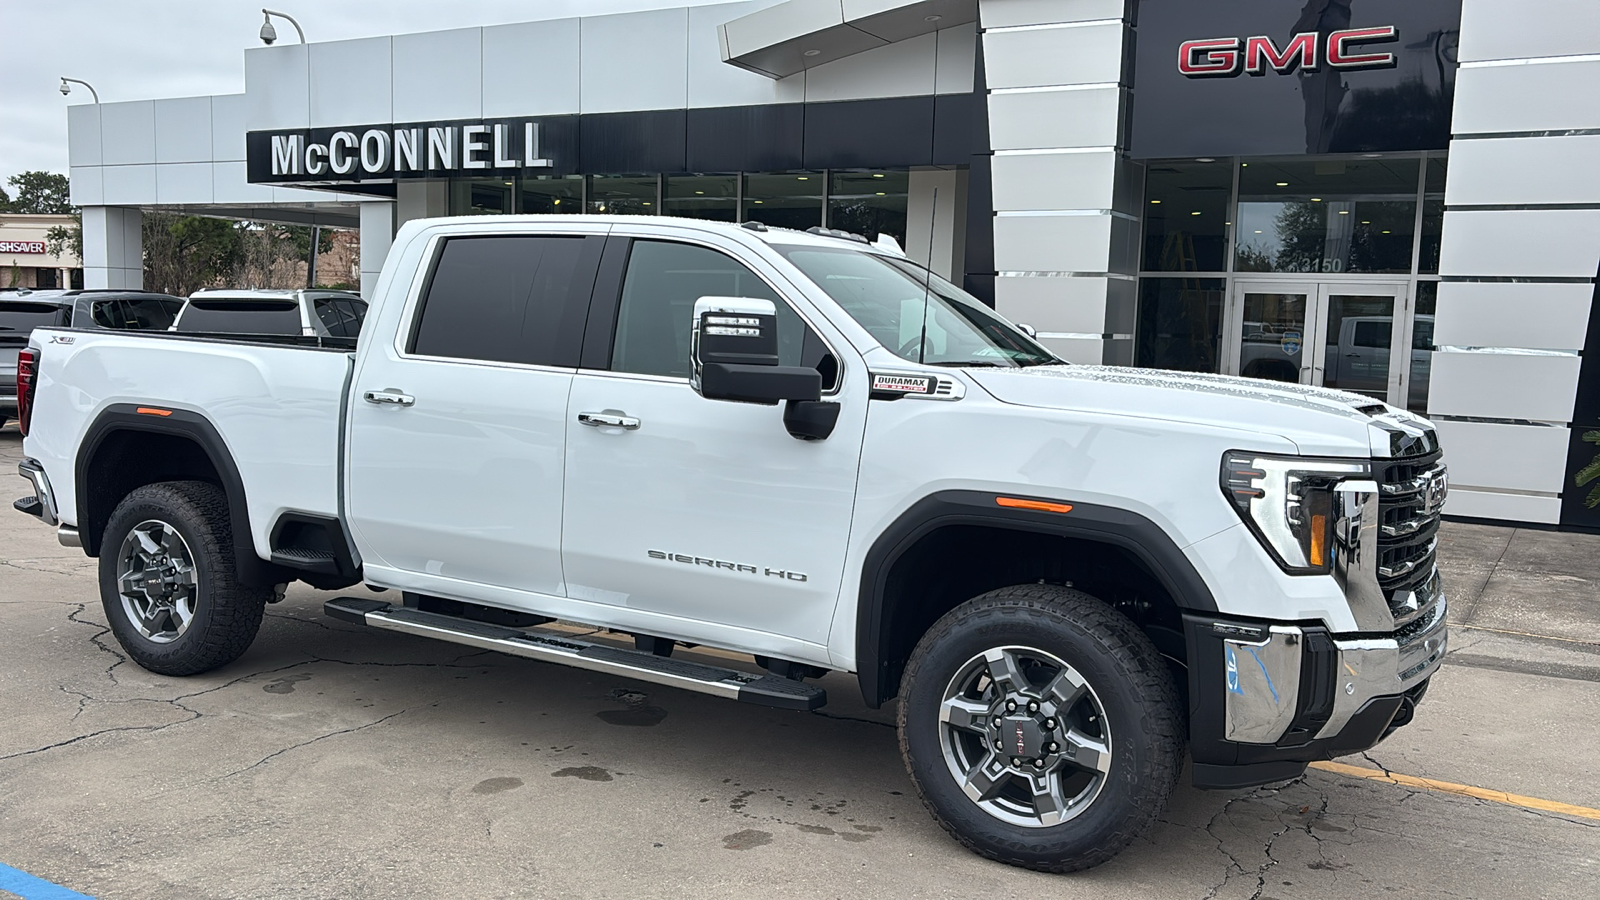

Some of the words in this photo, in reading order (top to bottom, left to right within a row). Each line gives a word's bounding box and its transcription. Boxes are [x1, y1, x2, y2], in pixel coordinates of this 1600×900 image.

[1178, 25, 1398, 77] GMC
[1302, 258, 1342, 272] 3150
[878, 376, 925, 386] DURAMAX
[647, 549, 757, 574] SIERRA
[764, 567, 808, 582] HD
[1014, 720, 1025, 755] GMC
